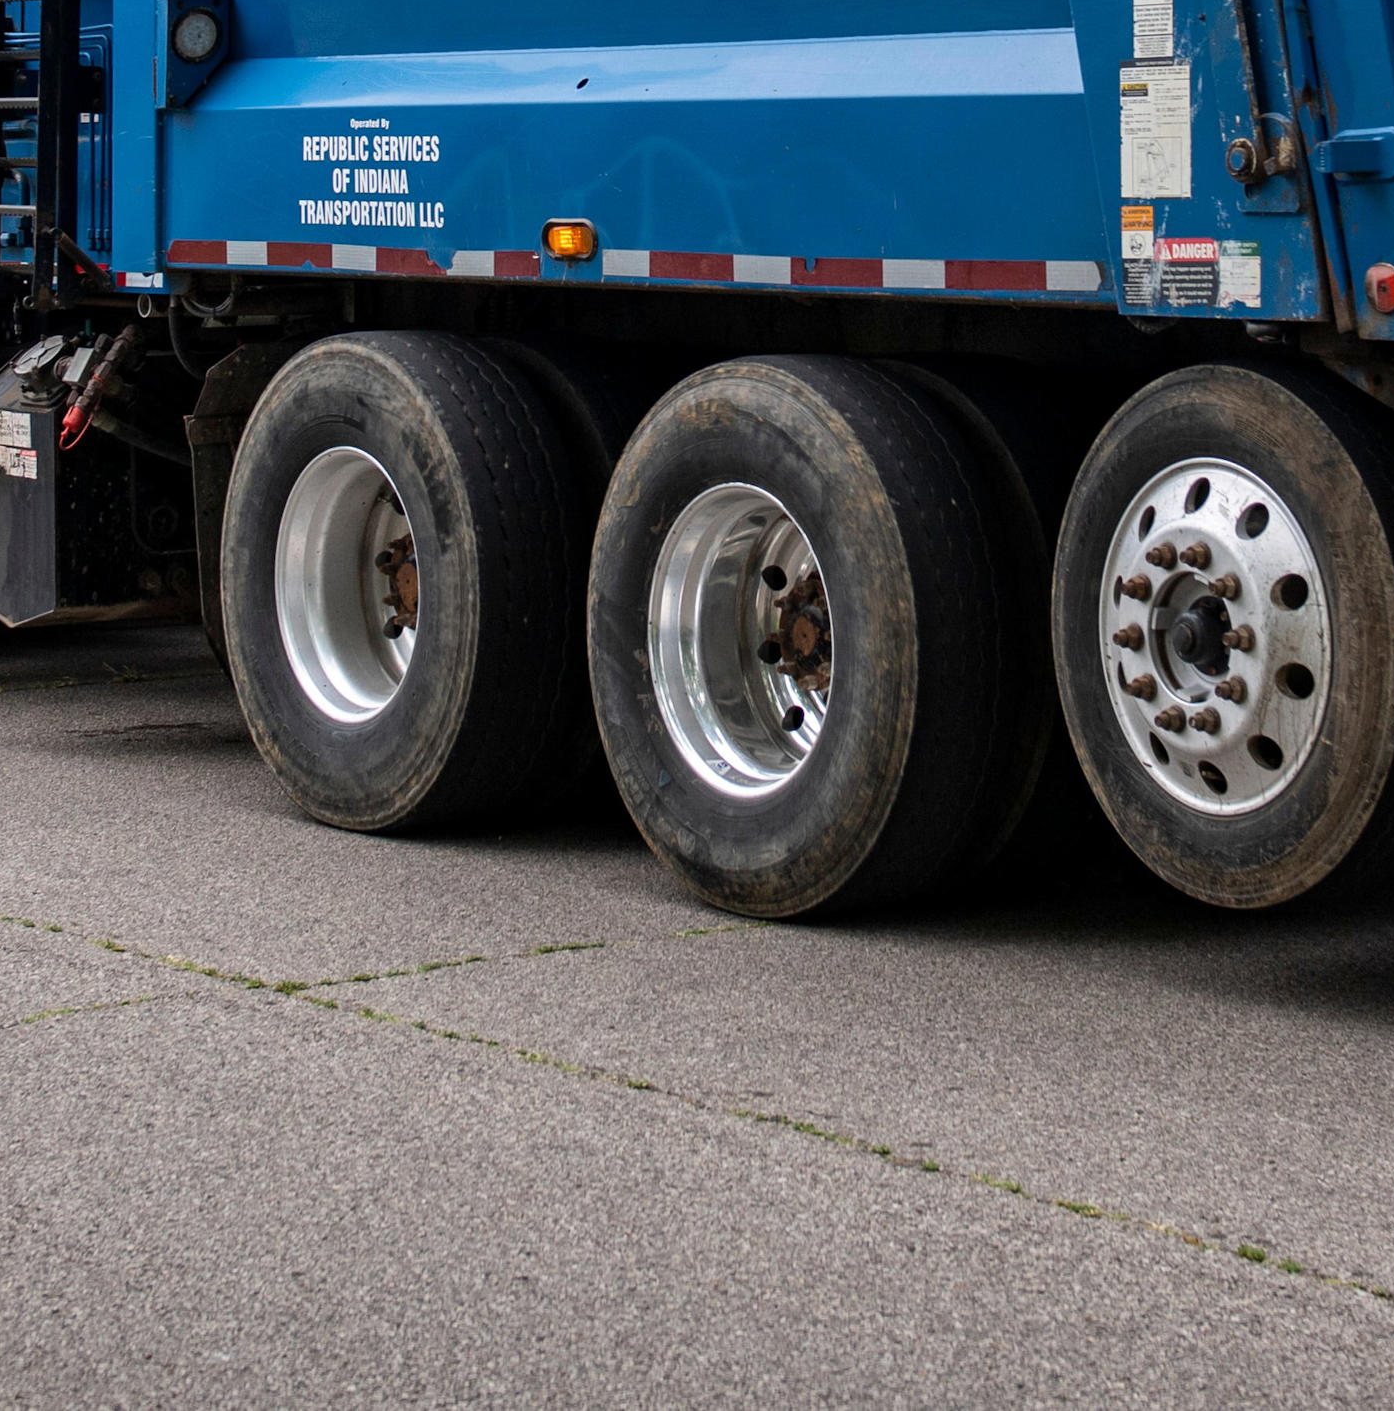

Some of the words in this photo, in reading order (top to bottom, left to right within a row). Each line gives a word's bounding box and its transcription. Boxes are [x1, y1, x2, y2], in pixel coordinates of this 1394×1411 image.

[350, 118, 379, 130] Operated
[381, 118, 390, 130] By
[303, 136, 369, 161] REPUBLIC
[373, 135, 440, 162] SERVICES
[332, 168, 350, 193] OF
[354, 168, 409, 194] INDIANA
[299, 200, 415, 227] TRANSPORTATION
[420, 202, 444, 228] LLC
[1171, 243, 1215, 259] DANGER
